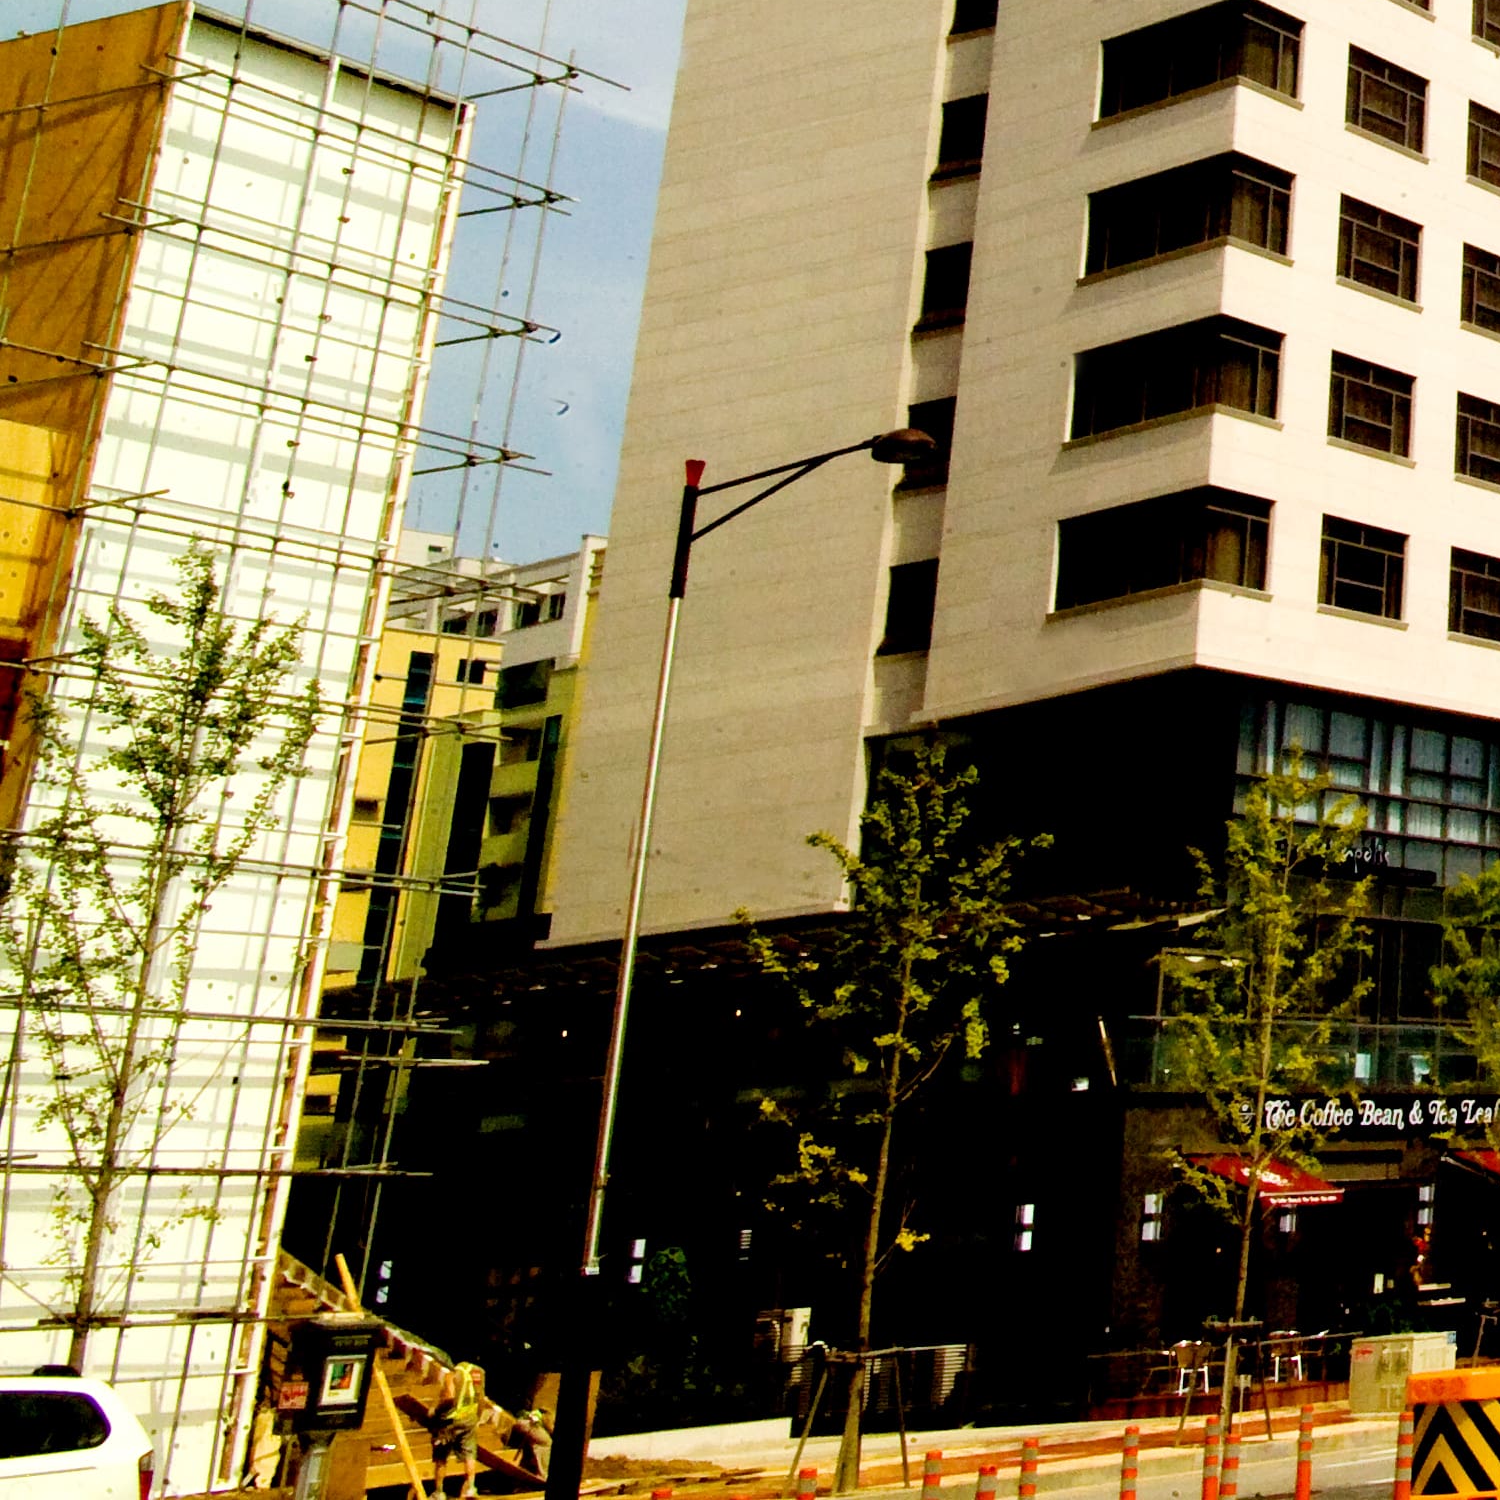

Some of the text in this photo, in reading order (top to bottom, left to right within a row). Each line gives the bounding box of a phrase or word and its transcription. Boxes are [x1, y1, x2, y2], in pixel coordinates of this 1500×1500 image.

[1265, 1100, 1296, 1131] The
[1300, 1099, 1353, 1127] Coffee
[1358, 1100, 1405, 1131] Bean
[1409, 1100, 1424, 1126] &
[1428, 1100, 1458, 1125] Tea
